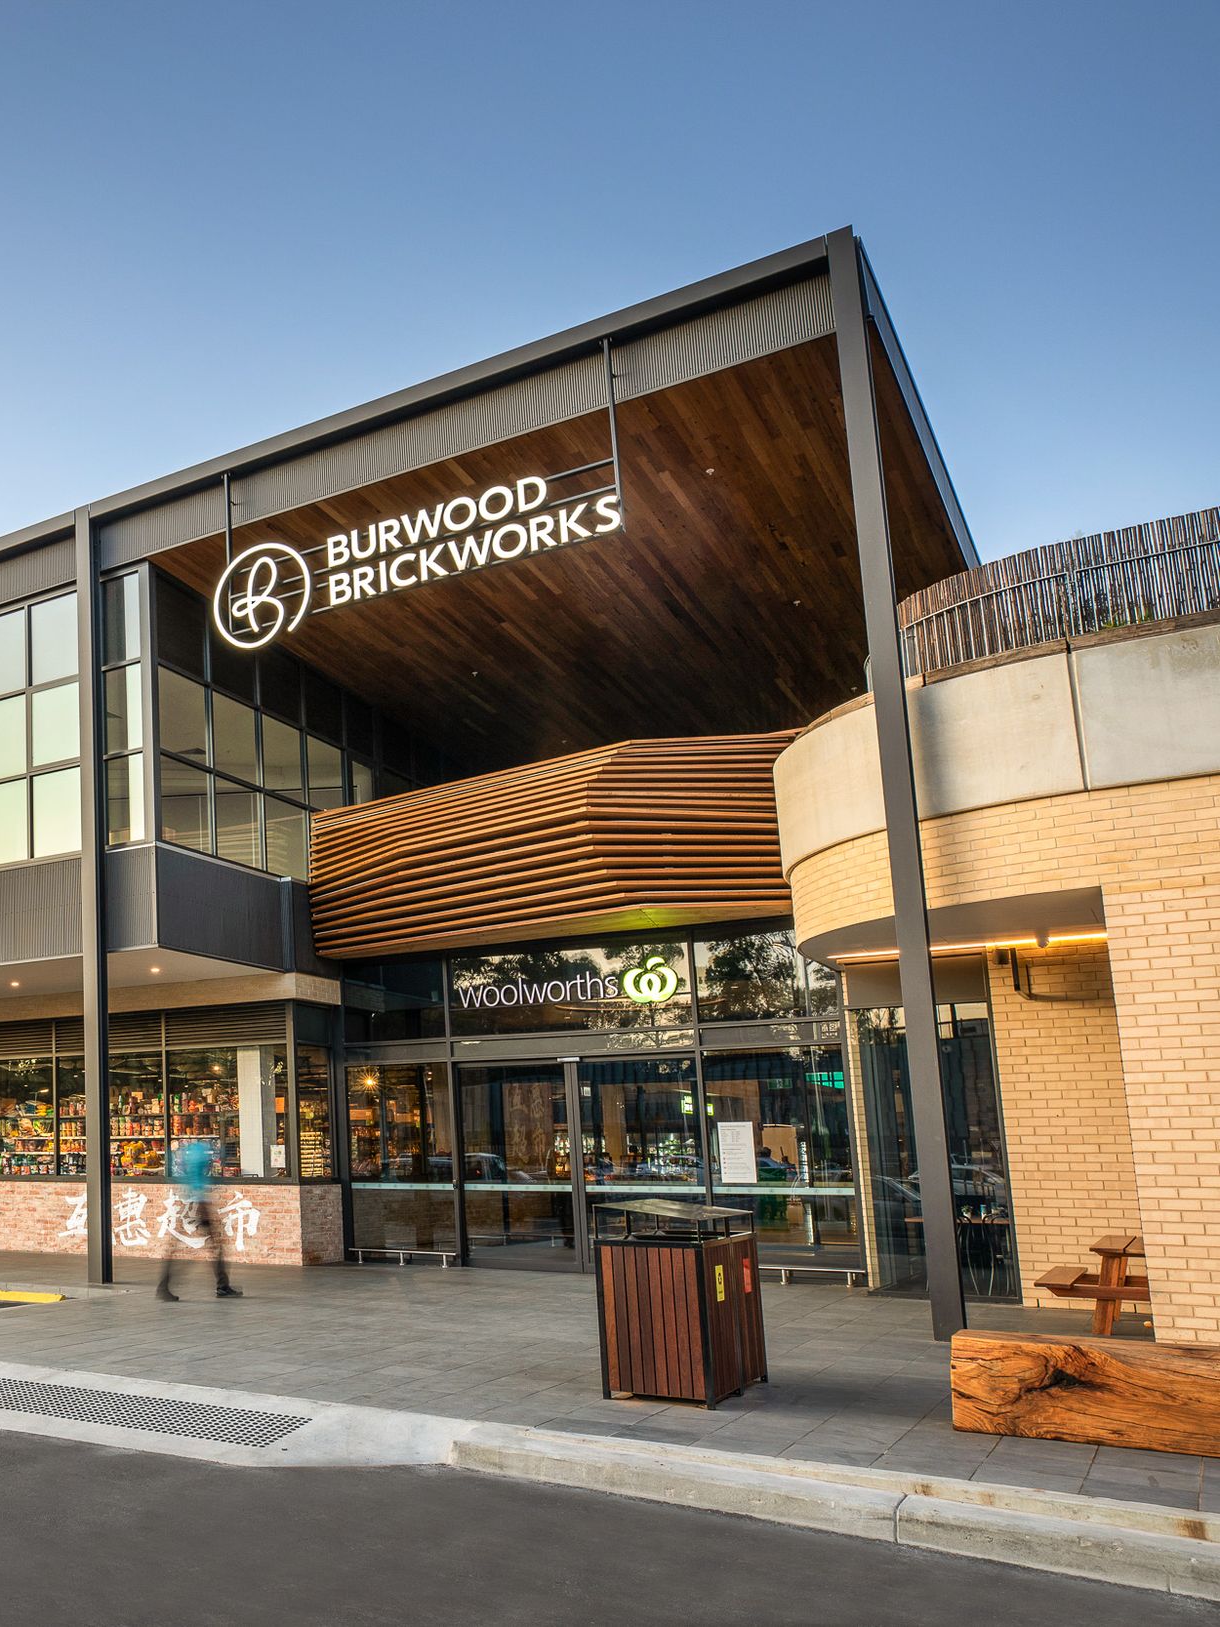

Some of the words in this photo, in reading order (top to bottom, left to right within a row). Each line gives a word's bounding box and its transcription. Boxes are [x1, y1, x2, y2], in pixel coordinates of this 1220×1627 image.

[327, 475, 547, 568] BURWOOD
[329, 495, 621, 606] BRICKWORKS
[459, 971, 619, 1009] woolworths
